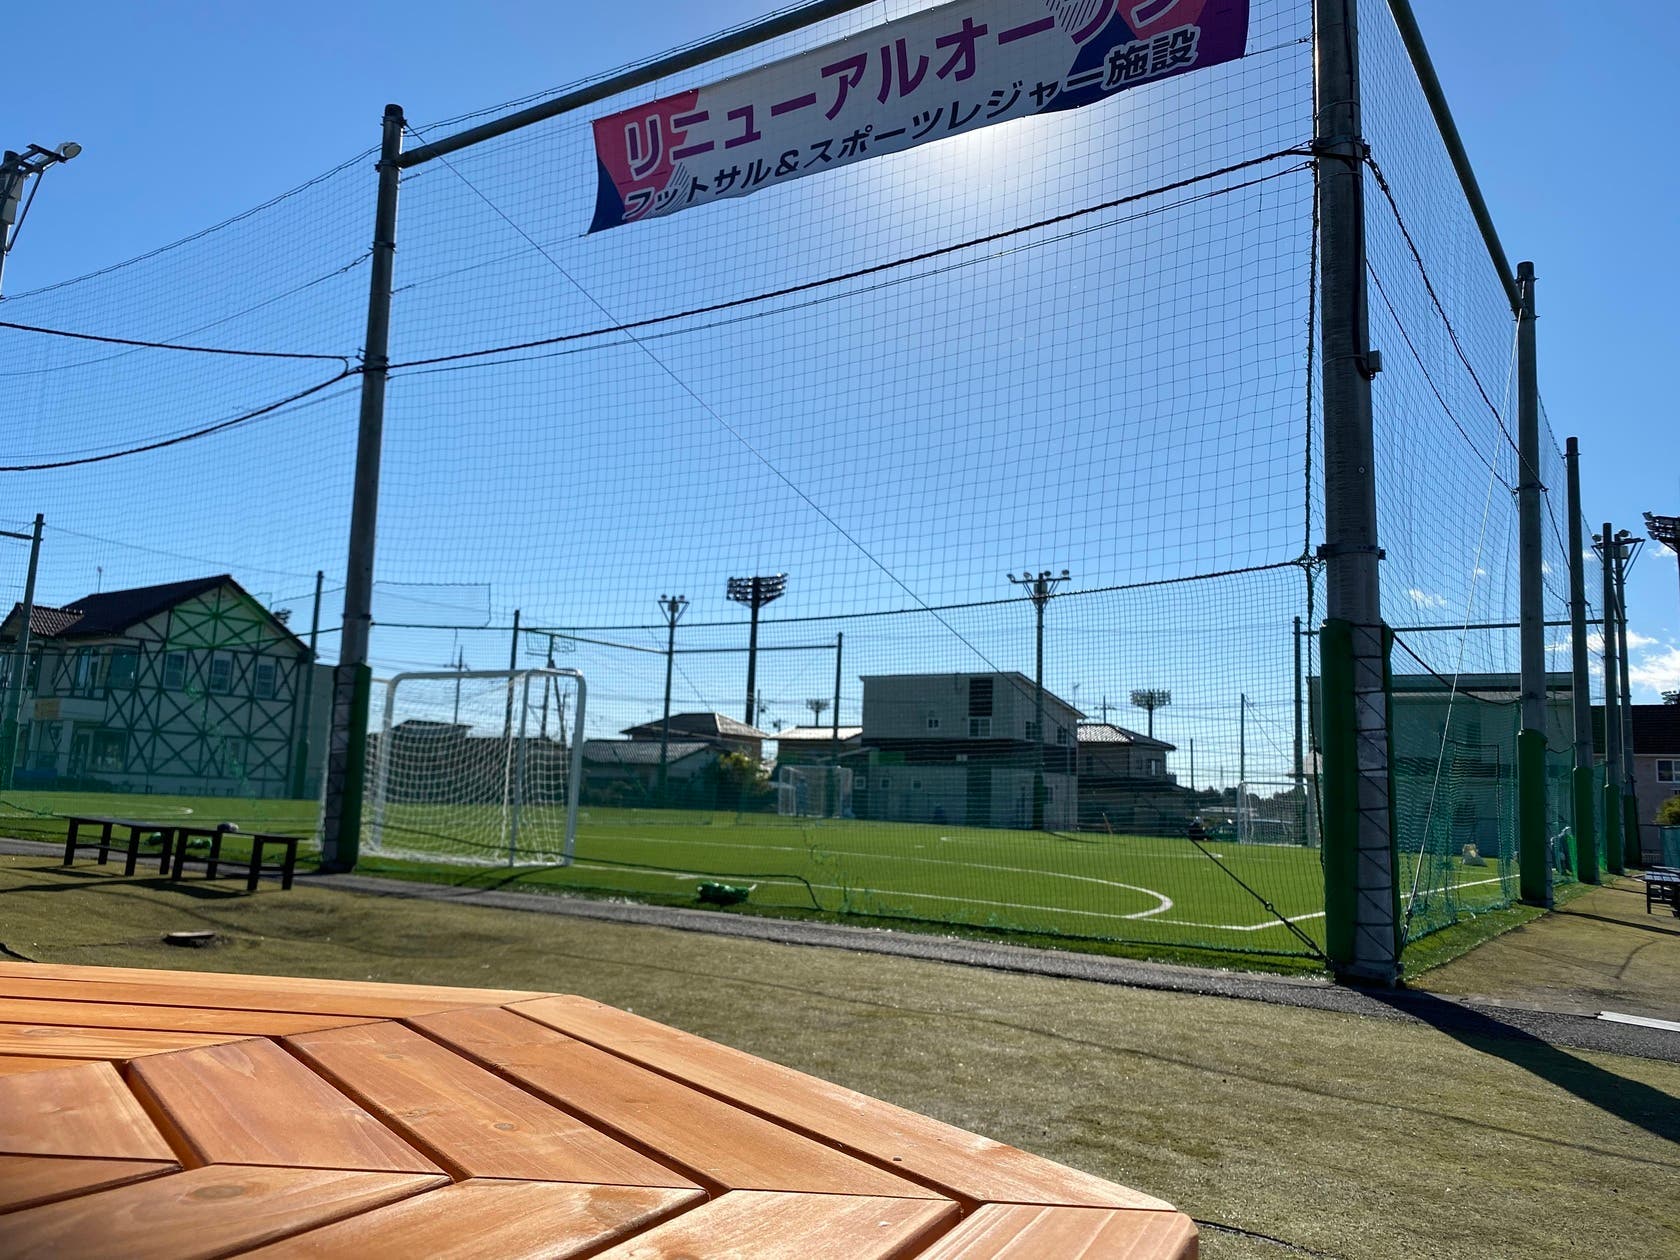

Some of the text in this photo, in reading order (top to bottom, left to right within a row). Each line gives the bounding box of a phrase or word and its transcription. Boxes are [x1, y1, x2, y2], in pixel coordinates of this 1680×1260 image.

[624, 29, 1197, 218] フットサル&スポーツレジャー施設
